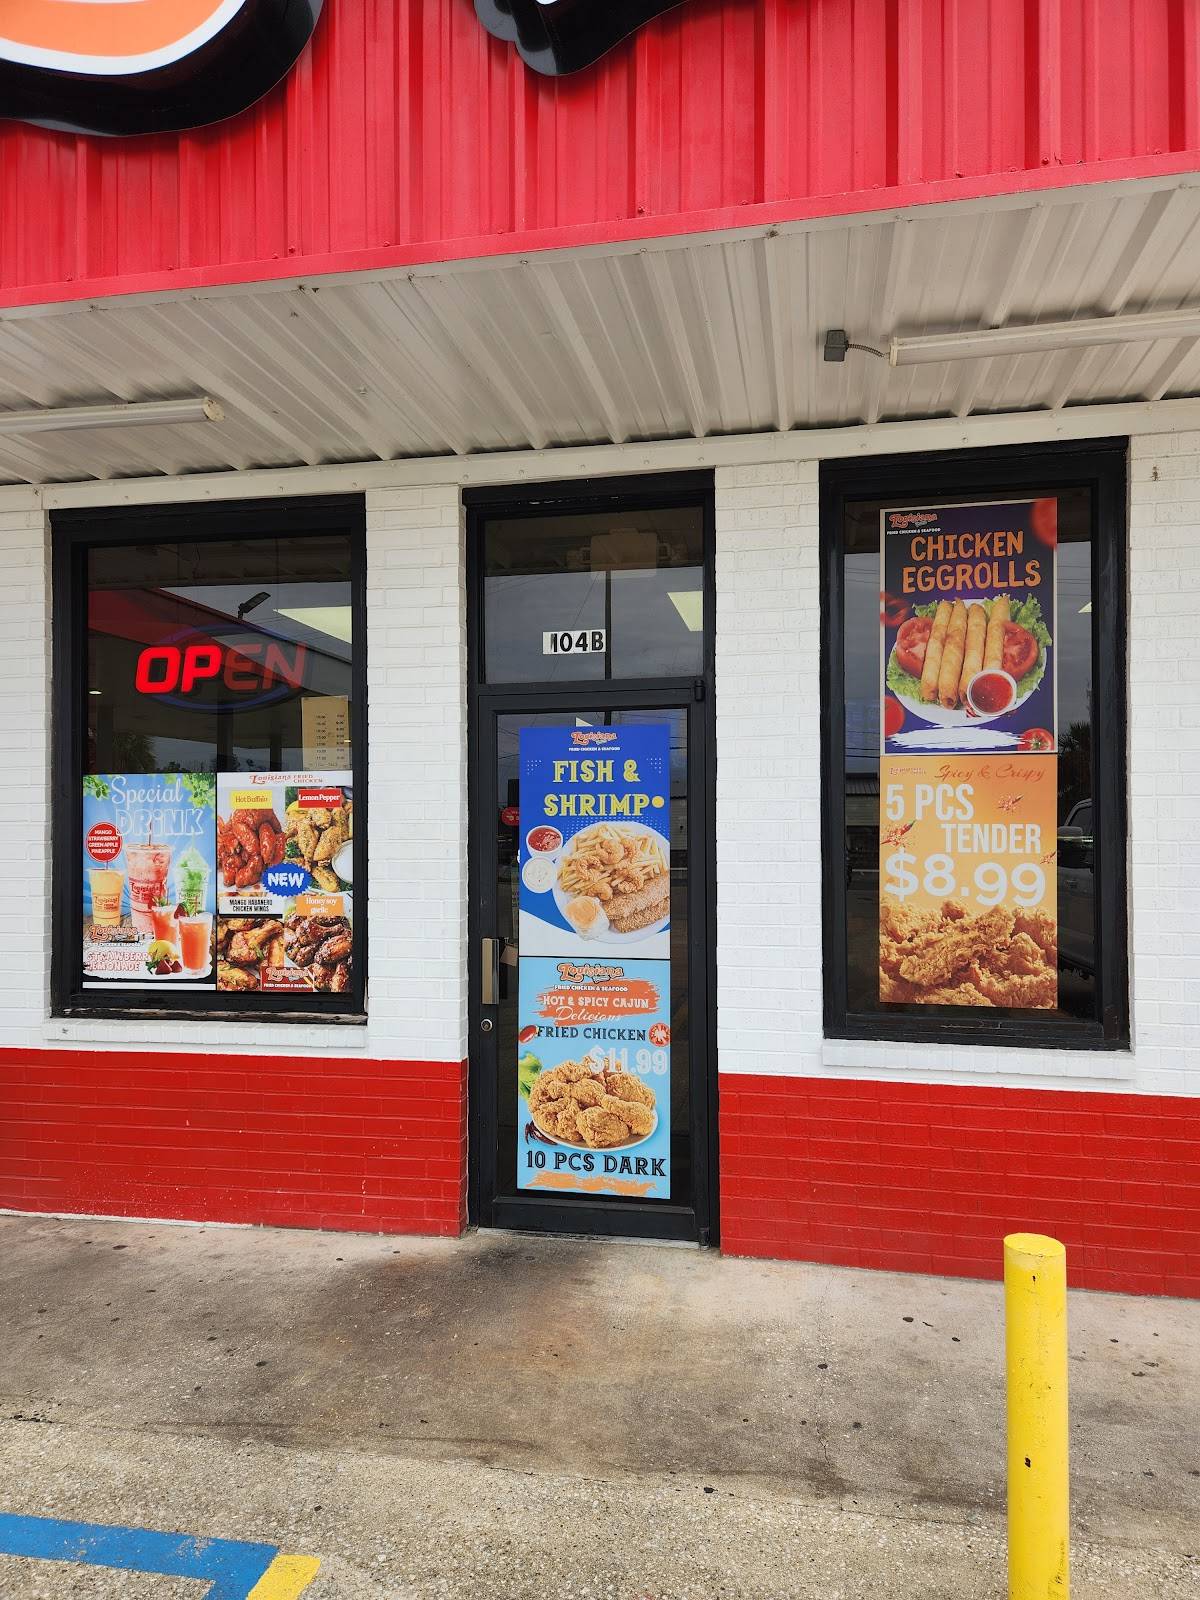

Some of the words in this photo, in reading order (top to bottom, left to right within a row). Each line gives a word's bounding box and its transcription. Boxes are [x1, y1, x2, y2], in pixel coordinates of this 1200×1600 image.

[910, 530, 1025, 562] CHICKEN
[902, 559, 1042, 594] EGGROLLS
[551, 631, 604, 652] 104B
[135, 641, 308, 694] OPEN
[552, 760, 614, 783] FISH
[623, 759, 640, 782] &
[934, 764, 972, 782] Spicy
[995, 763, 1045, 782] Crispy
[111, 775, 184, 811] Special
[235, 795, 247, 803] Hot
[298, 793, 319, 801] Lemon
[319, 793, 340, 803] Pepper
[544, 793, 649, 817] SHRIMP
[886, 783, 904, 820] 5
[915, 783, 974, 821] PCS
[941, 823, 1041, 854] TENDER
[267, 871, 305, 889] NEW
[884, 847, 1046, 907] $8.99
[557, 962, 624, 983] Louisiana
[542, 995, 566, 1006] HOT
[567, 996, 574, 1006] &
[578, 996, 609, 1007] SPICY
[612, 998, 649, 1009] CAJUN
[555, 1005, 623, 1022] Delicious
[537, 1025, 579, 1038] FRIED
[583, 1027, 646, 1041] CHICKEN
[589, 1044, 668, 1075] $11.99
[526, 1150, 546, 1169] 10
[554, 1152, 595, 1172] PCS
[604, 1154, 667, 1177] DARK
